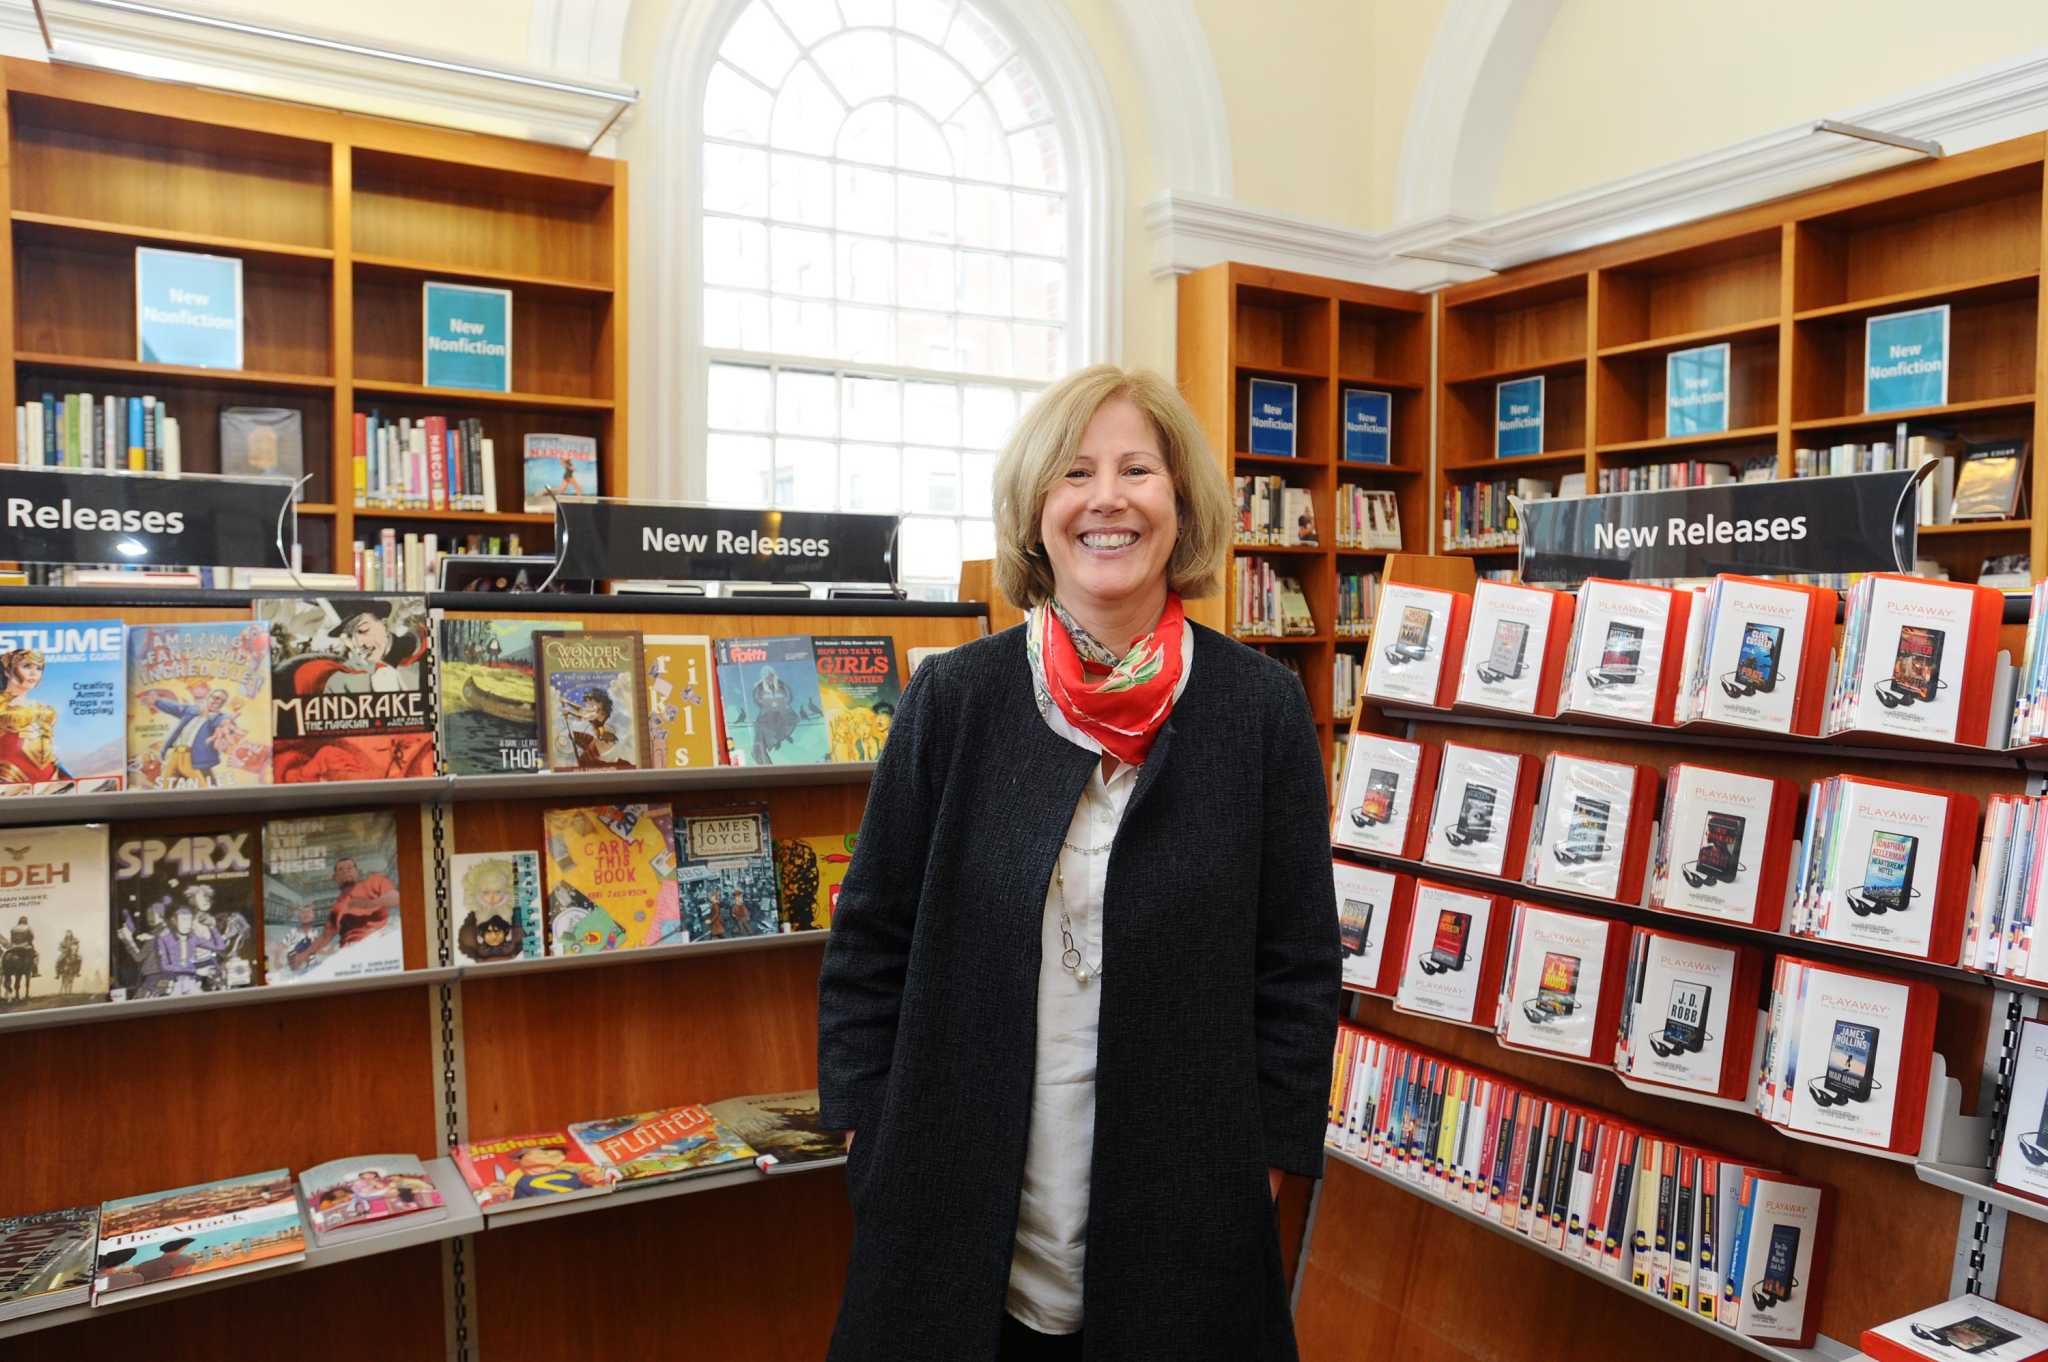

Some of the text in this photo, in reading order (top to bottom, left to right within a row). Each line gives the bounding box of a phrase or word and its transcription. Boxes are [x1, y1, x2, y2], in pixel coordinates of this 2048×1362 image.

[169, 288, 209, 305] New
[143, 307, 235, 331] Nonfiction
[449, 318, 485, 336] New
[428, 336, 505, 357] Nonfiction
[1890, 344, 1921, 358] New
[1870, 358, 1942, 380] Nonfiction
[1685, 376, 1709, 389] New
[1669, 390, 1725, 408] Nonfiction
[1263, 403, 1283, 415] New
[1510, 404, 1530, 415] New
[1251, 415, 1294, 430] Nonfiction
[1358, 412, 1377, 423] New
[1499, 416, 1541, 432] Nonfiction
[1346, 422, 1388, 435] Nonfiction
[7, 498, 184, 535] Releases
[1594, 513, 1807, 550] New Releases
[642, 526, 830, 558] New Releases
[1734, 600, 1792, 615] PLAYAWAY
[1887, 601, 1952, 616] PLAYAWAY
[552, 643, 626, 658] WONDER
[559, 656, 617, 669] WOMAN
[817, 656, 889, 674] GIRLS
[73, 707, 113, 716] Cosplay
[272, 693, 424, 736] MANDRAKE
[305, 719, 369, 731] THE MAGICIAN
[1695, 787, 1755, 803] PLAYAWAY
[1858, 805, 1928, 823] PLAYAWAY
[700, 820, 750, 834] JAMES
[584, 839, 644, 857] CARRY
[698, 832, 752, 848] JOYCE
[1875, 839, 1906, 852] JONATHAN
[595, 855, 630, 868] THIS
[1872, 848, 1905, 861] KELLERMAN
[1871, 858, 1904, 871] HEARTBREAK
[0, 862, 70, 888] DEH
[594, 867, 636, 885] BOOK
[1661, 956, 1719, 973] PLAYAWAY
[1679, 992, 1698, 1008] J. D.
[1821, 994, 1889, 1013] PLAYAWAY
[1671, 1005, 1698, 1023] ROBB
[1840, 1026, 1865, 1040] JAMES
[1835, 1034, 1869, 1050] ROLLINS
[469, 1135, 567, 1158] Jughead
[1765, 1200, 1809, 1212] PLAYAWAY
